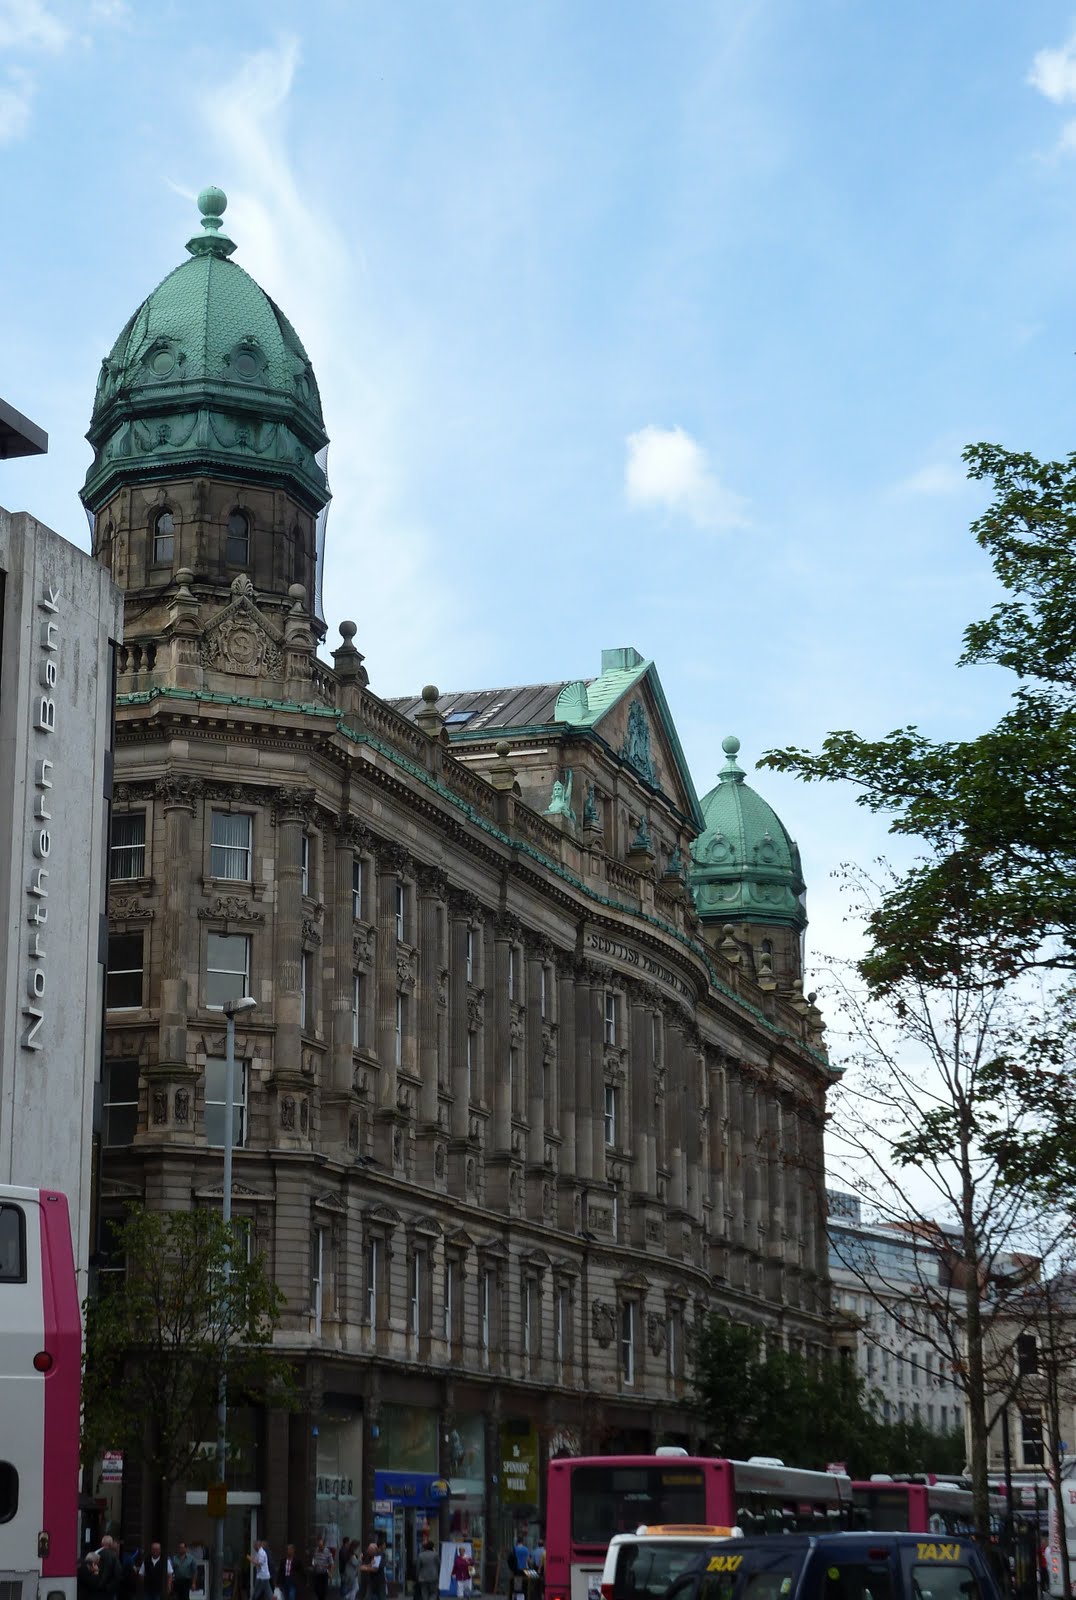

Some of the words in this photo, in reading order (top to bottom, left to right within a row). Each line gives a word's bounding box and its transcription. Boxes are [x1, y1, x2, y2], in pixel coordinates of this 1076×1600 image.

[33, 586, 60, 734] Bank
[20, 758, 54, 1052] Northern
[591, 934, 640, 965] SCOTTISH
[503, 1460, 530, 1474] SPINNING
[317, 1478, 353, 1500] AEGER
[916, 1543, 961, 1561] TAXI
[706, 1555, 743, 1572] TAXI
